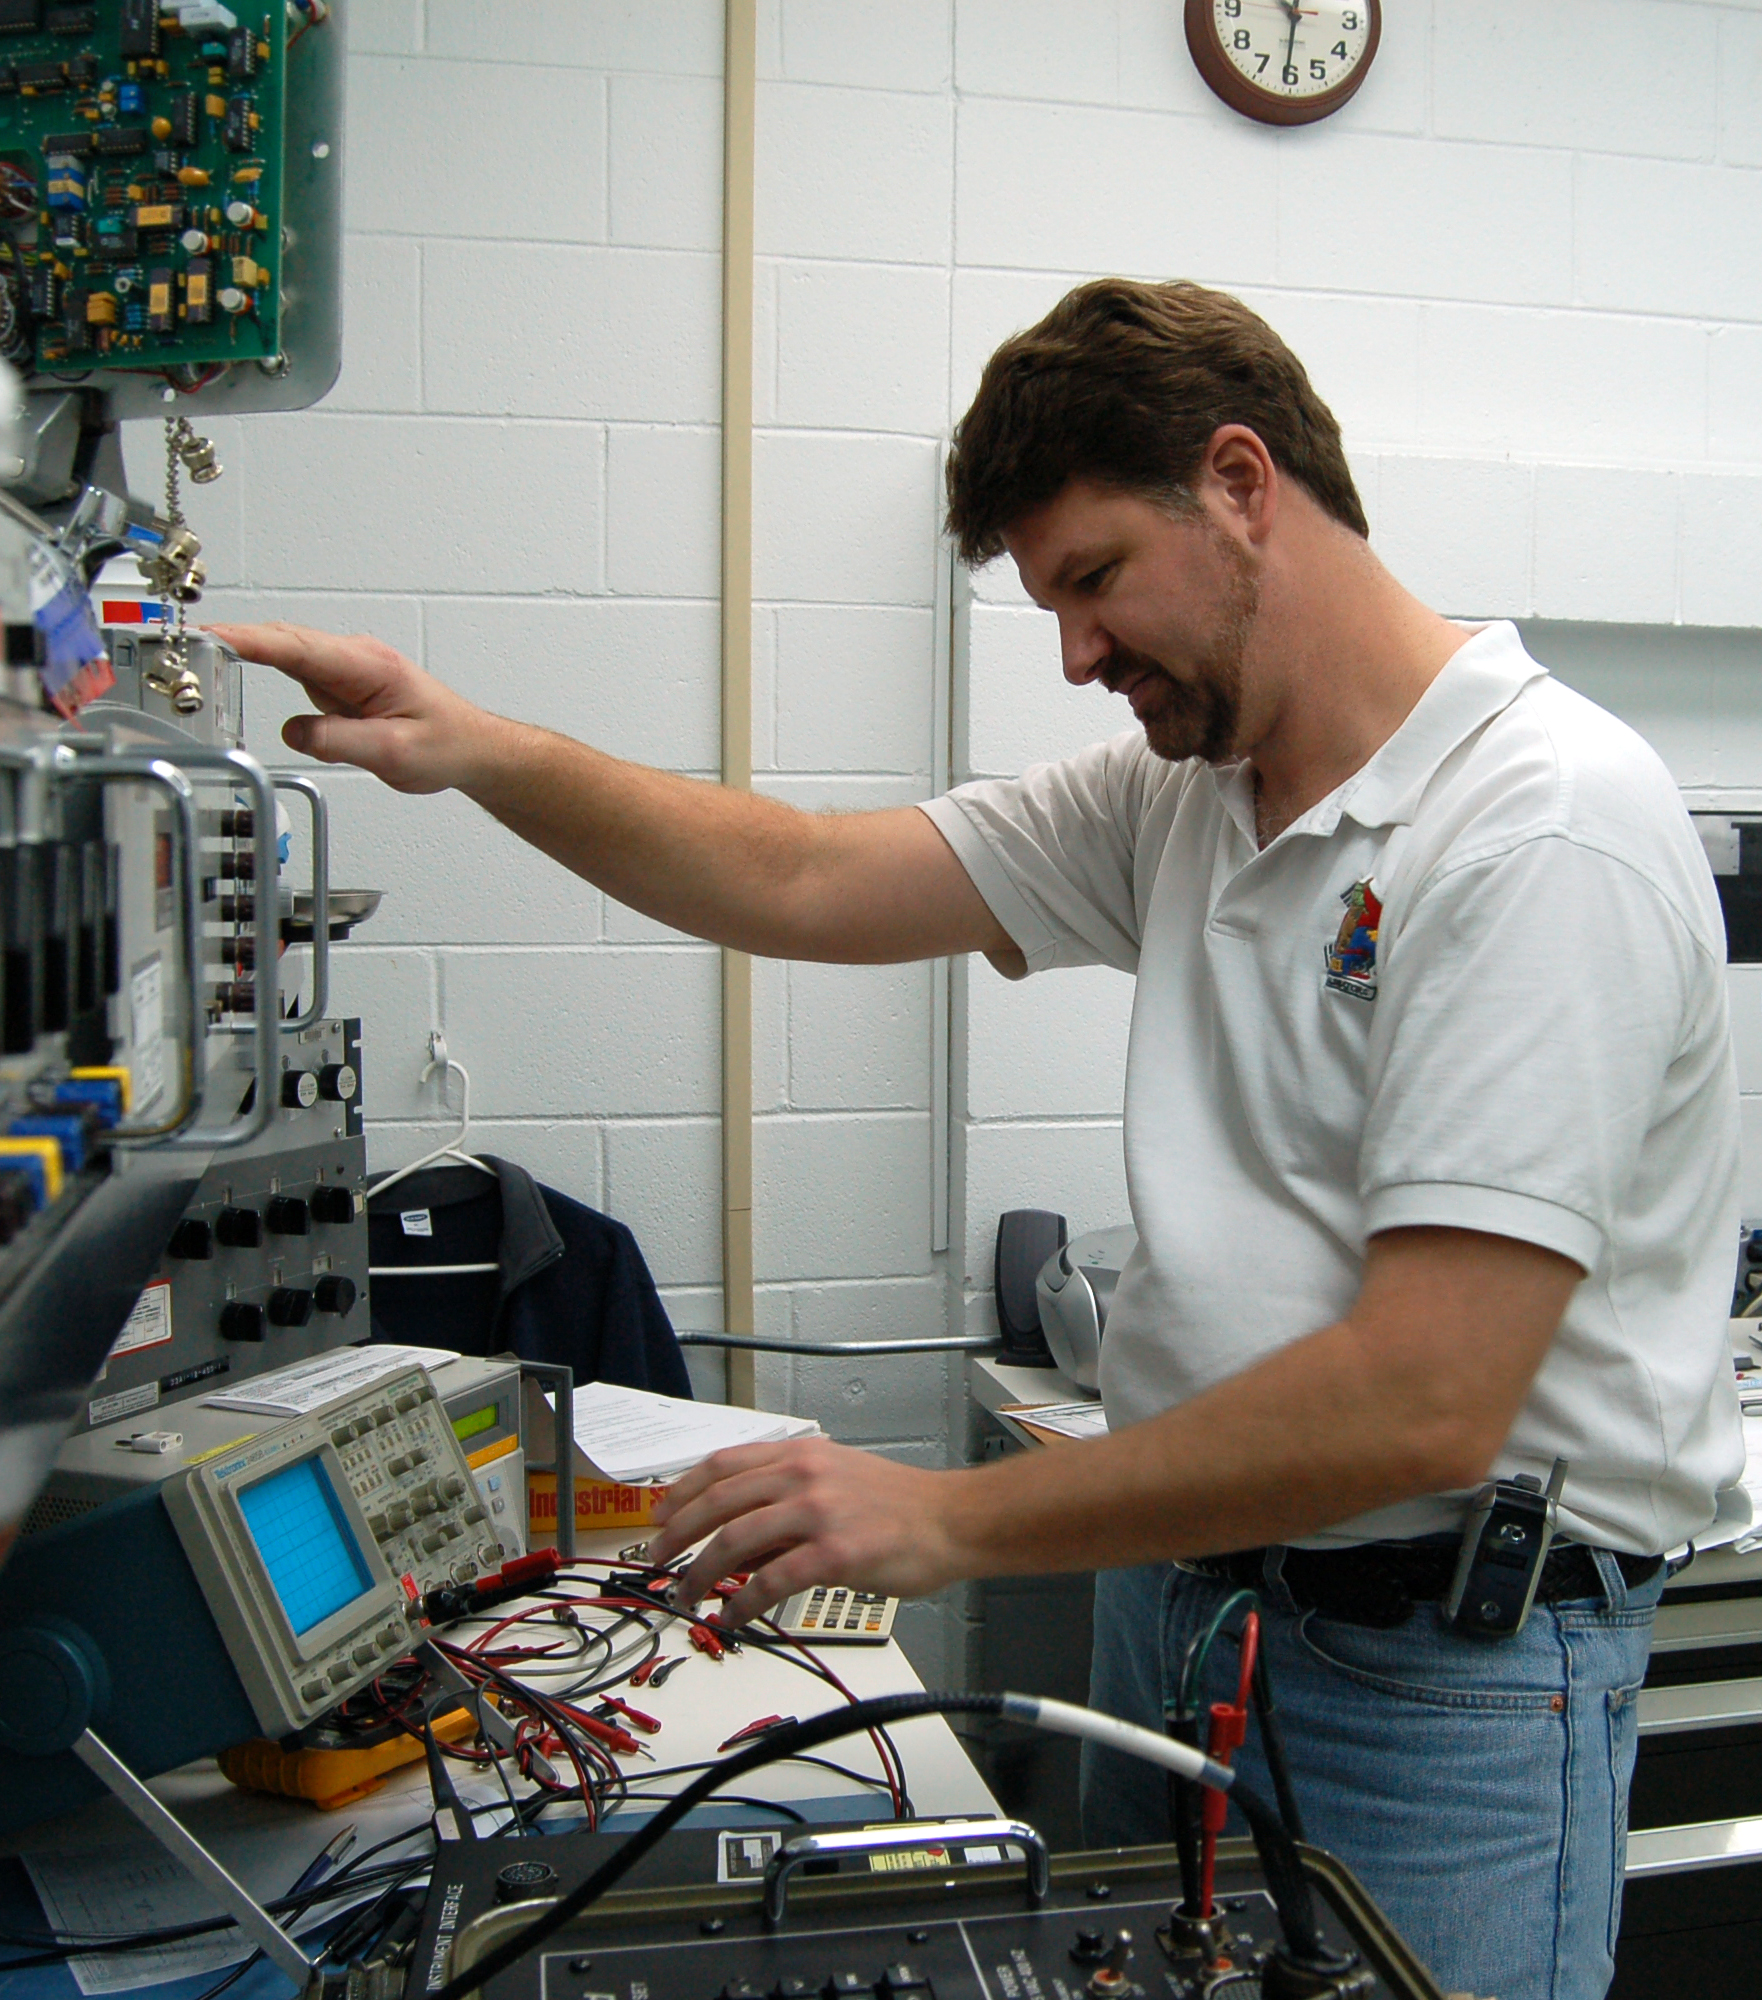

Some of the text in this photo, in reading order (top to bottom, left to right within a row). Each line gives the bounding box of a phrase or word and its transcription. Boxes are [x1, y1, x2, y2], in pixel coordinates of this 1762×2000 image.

[1224, 0, 1242, 18] 9
[1341, 10, 1358, 30] 3
[1233, 29, 1251, 50] 8
[1331, 40, 1347, 61] 4
[1254, 53, 1270, 74] 7
[1309, 59, 1326, 80] 5
[1282, 65, 1299, 85] 6
[529, 1483, 641, 1518] Indstrial
[426, 1884, 464, 1991] INSTRUMENT INTERFACE
